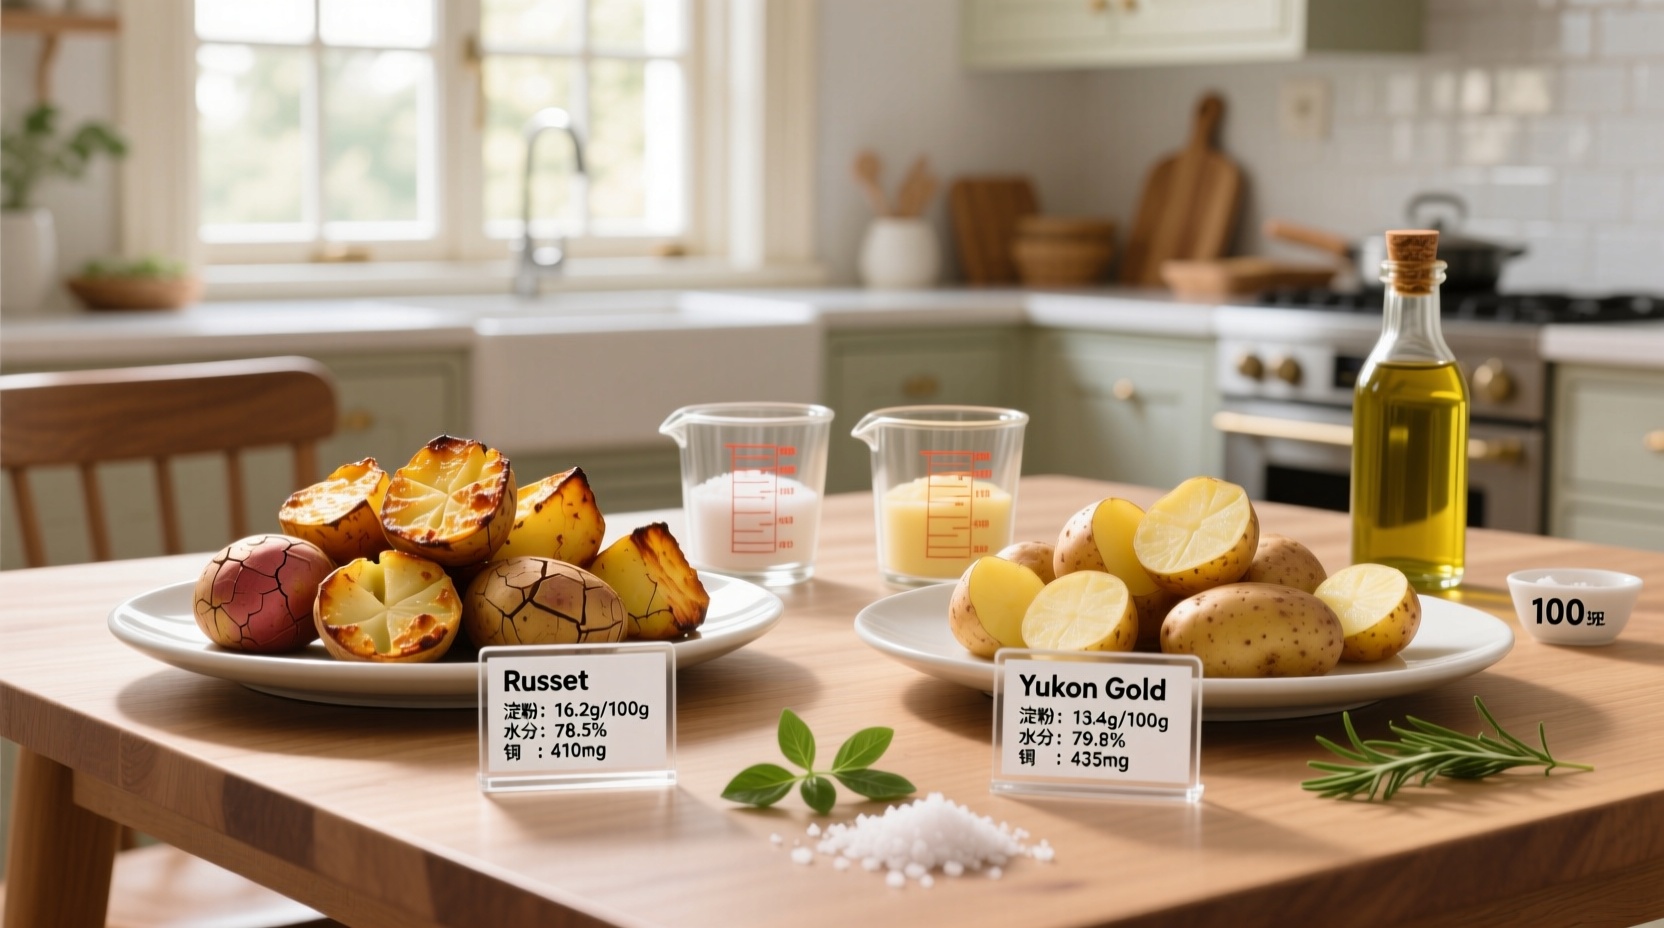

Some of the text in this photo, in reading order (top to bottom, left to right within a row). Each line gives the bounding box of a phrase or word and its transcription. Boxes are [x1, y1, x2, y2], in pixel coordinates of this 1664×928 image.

[504, 670, 589, 692] Russet
[1019, 674, 1166, 701] Yukon Gold
[554, 701, 650, 721] 16.2g/100g
[1072, 709, 1169, 733] 13.4g/100g
[554, 722, 608, 738] 78.5%
[1072, 731, 1126, 748] 79.8%
[550, 742, 607, 761] 410mg
[1070, 751, 1130, 773] 435mg
